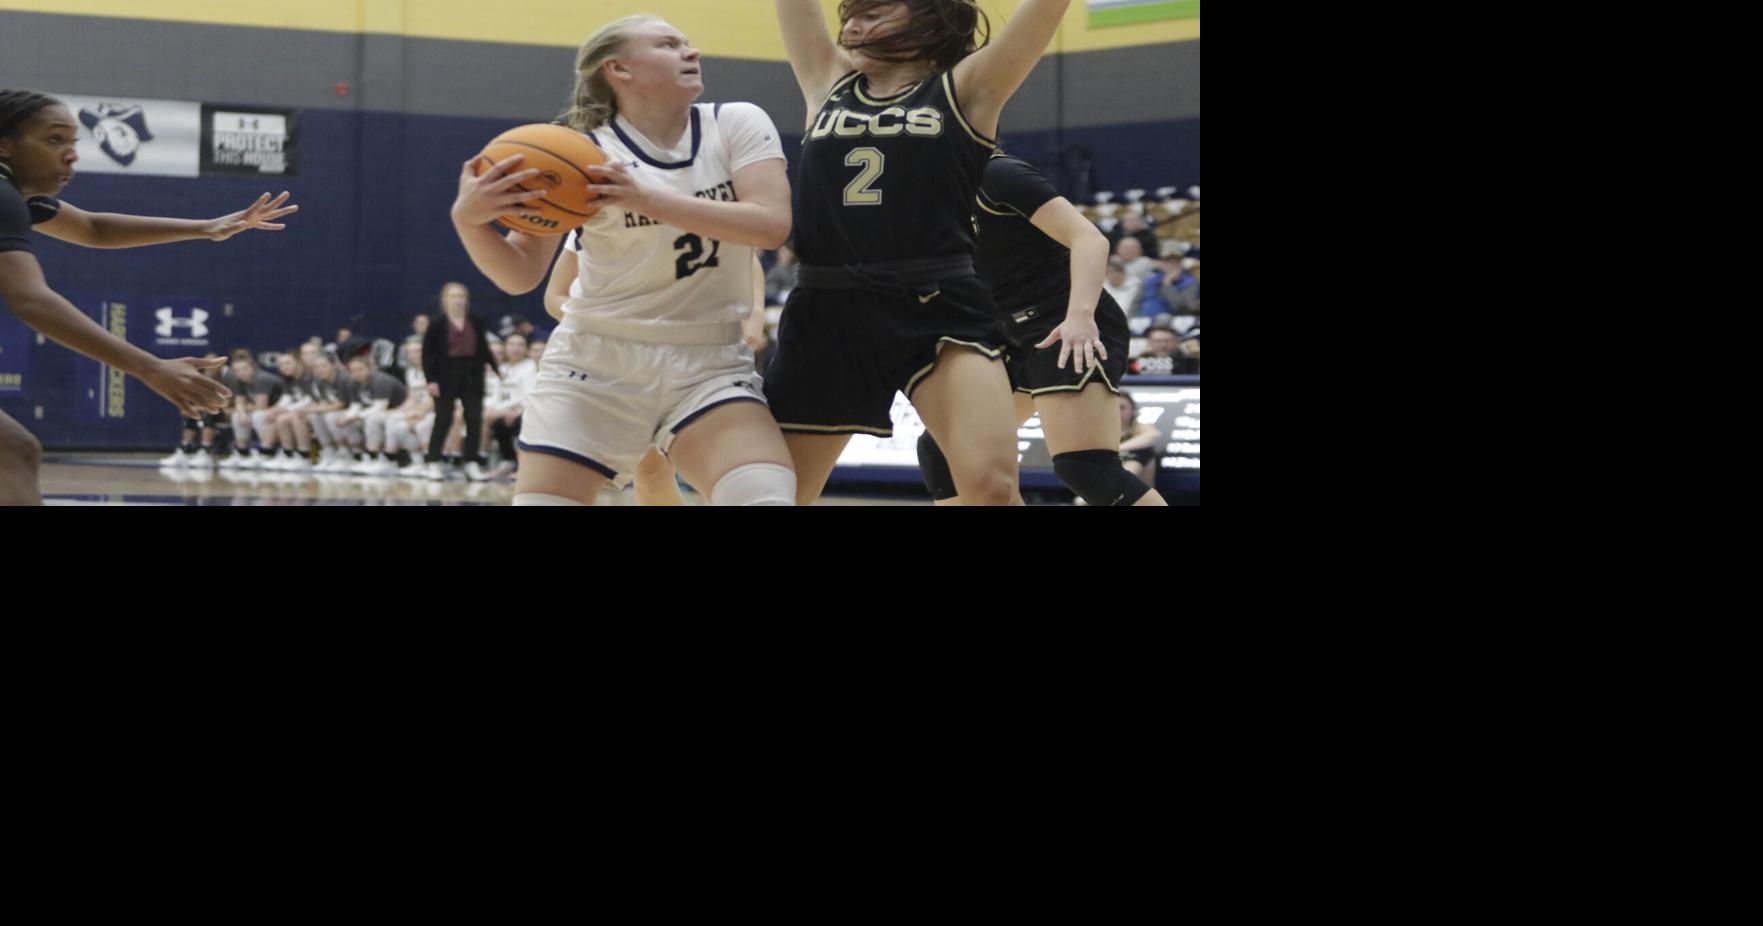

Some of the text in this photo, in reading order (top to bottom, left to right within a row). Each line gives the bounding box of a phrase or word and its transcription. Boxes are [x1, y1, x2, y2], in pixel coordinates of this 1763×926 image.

[811, 106, 943, 138] UCCS
[213, 131, 288, 151] PROTECT
[843, 147, 885, 206] 2
